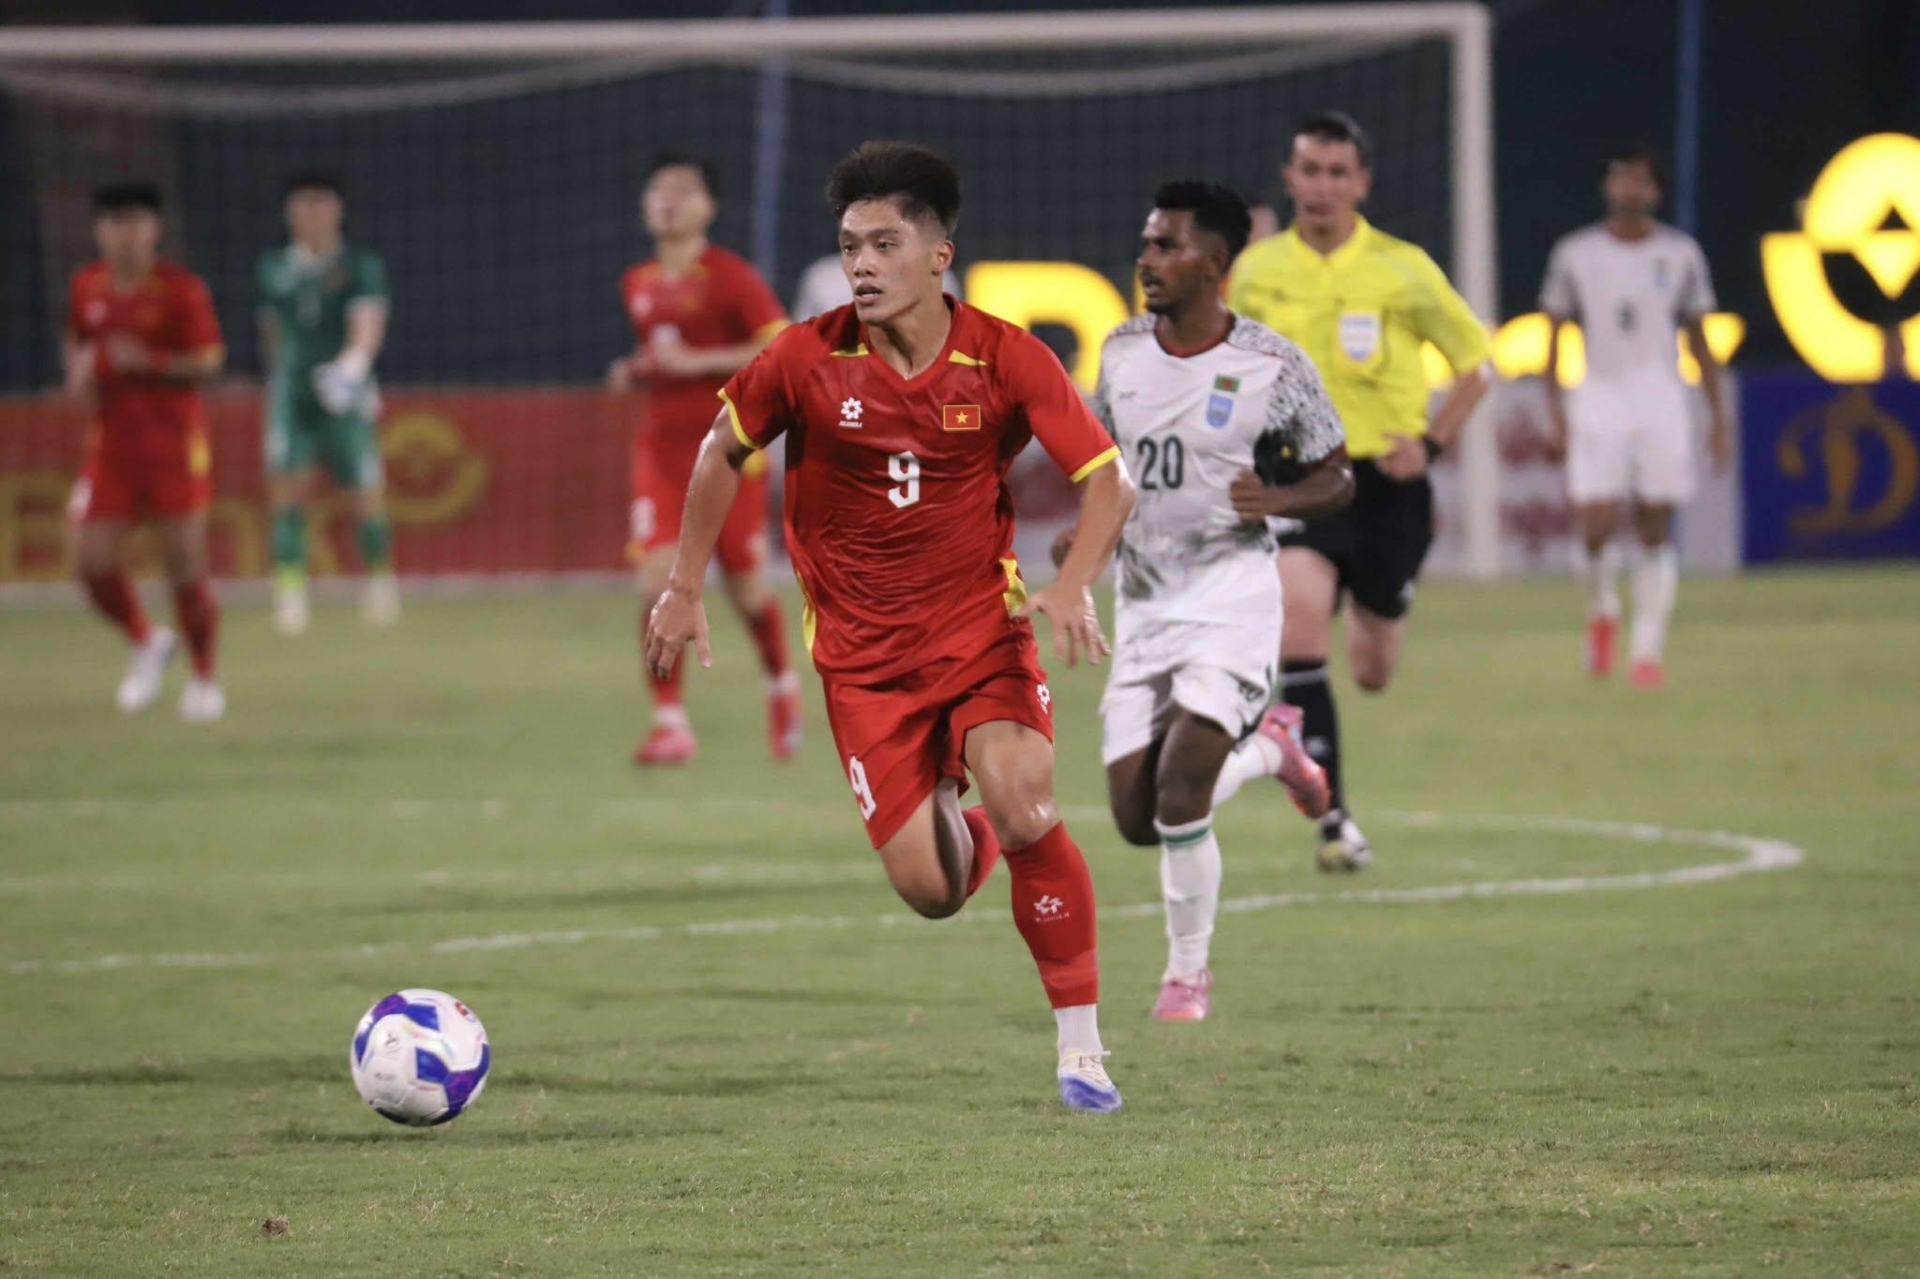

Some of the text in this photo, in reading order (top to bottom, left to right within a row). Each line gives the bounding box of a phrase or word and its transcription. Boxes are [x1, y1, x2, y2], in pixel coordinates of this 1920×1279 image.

[888, 450, 920, 508] 9
[1138, 435, 1184, 490] 20
[850, 756, 877, 820] 9
